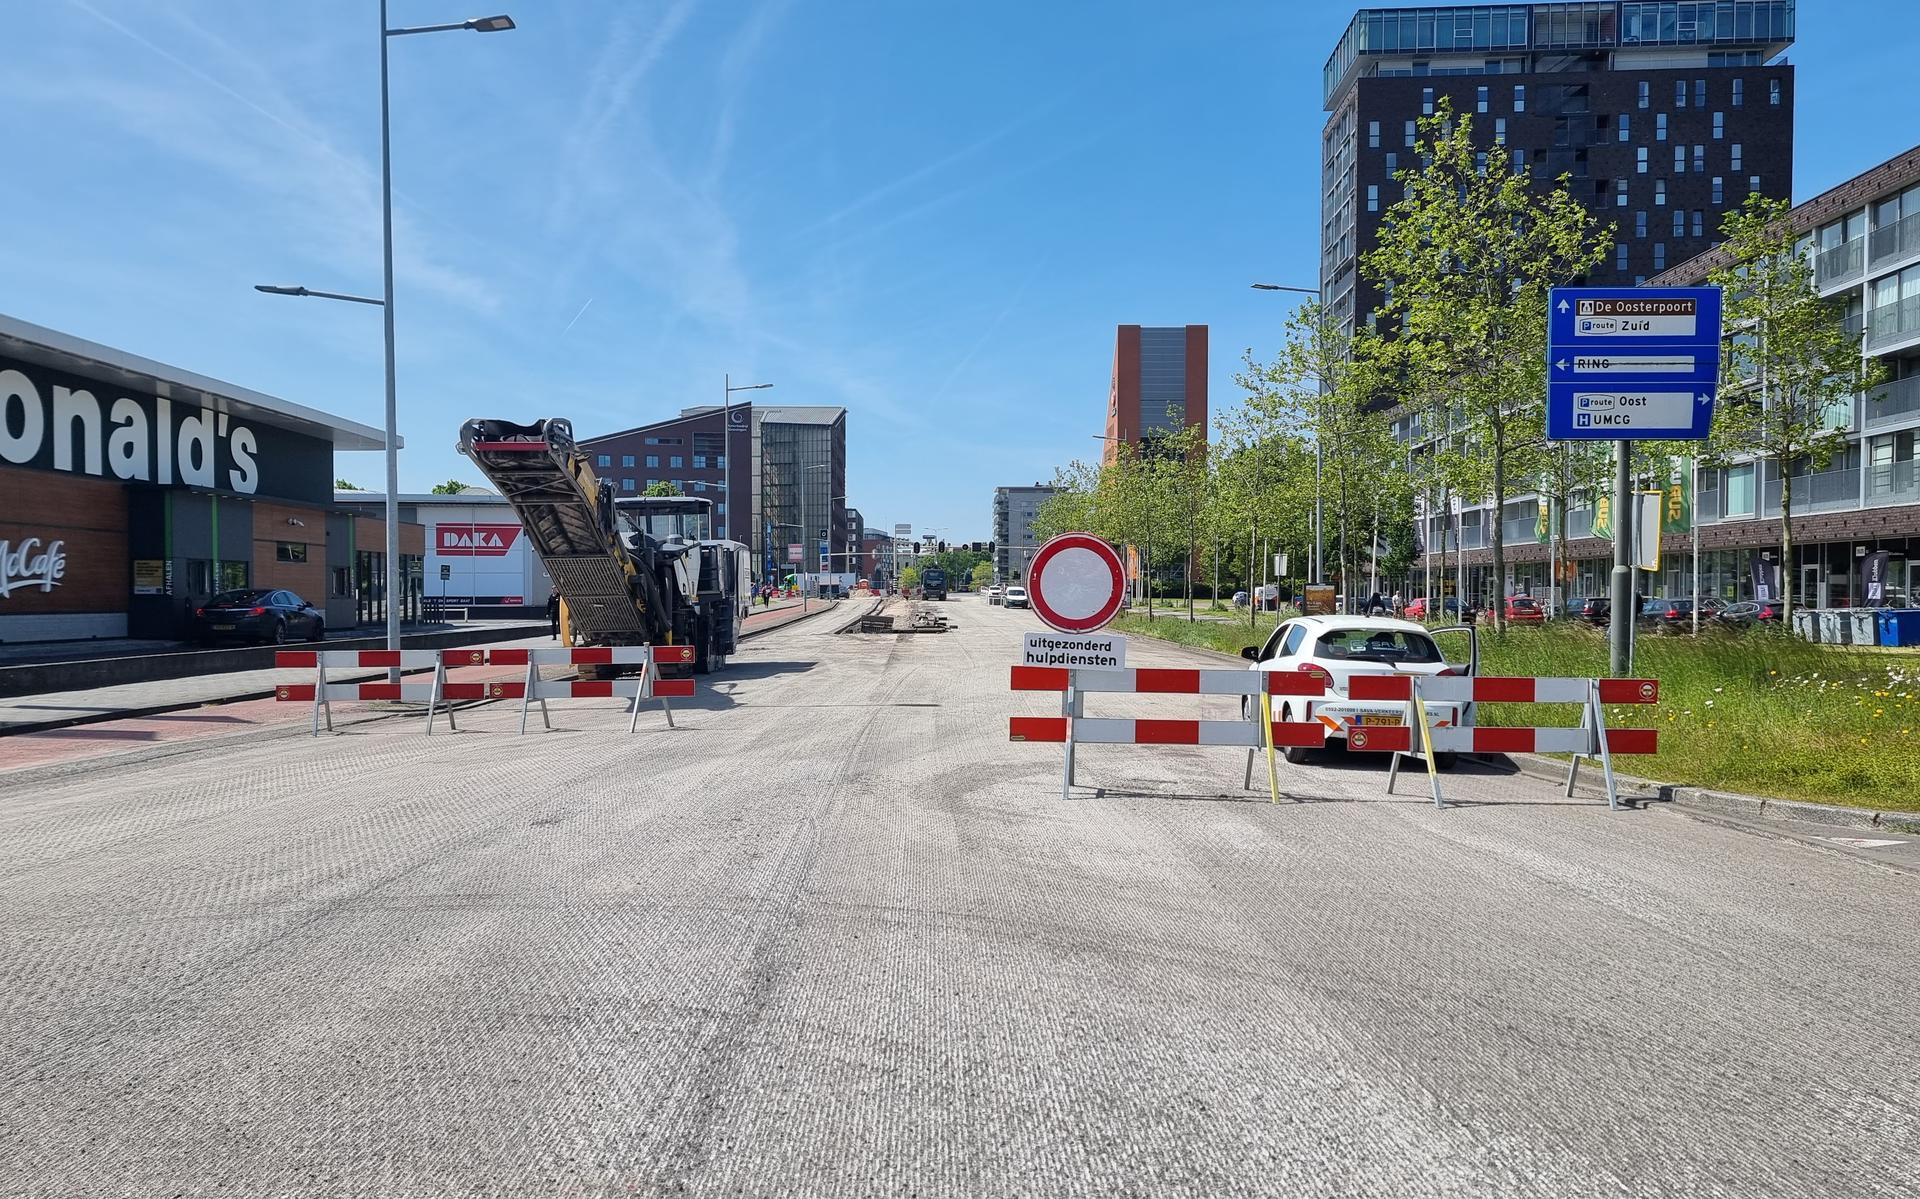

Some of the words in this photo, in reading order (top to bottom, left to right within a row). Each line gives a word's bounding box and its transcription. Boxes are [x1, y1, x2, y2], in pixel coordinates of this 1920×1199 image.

[1596, 301, 1612, 312] De
[1616, 301, 1693, 314] Oosterpoort
[1621, 320, 1650, 331] Zuid
[1577, 359, 1610, 369] RING
[1590, 398, 1613, 406] route
[1619, 396, 1647, 406] Oost
[1594, 415, 1631, 425] UMCG
[443, 532, 504, 547] DAKA
[165, 560, 173, 596] AFHALEN
[1030, 638, 1112, 652] uitgezonderd
[1026, 651, 1117, 666] hulpdiensten
[1365, 717, 1401, 726] P-791-P
